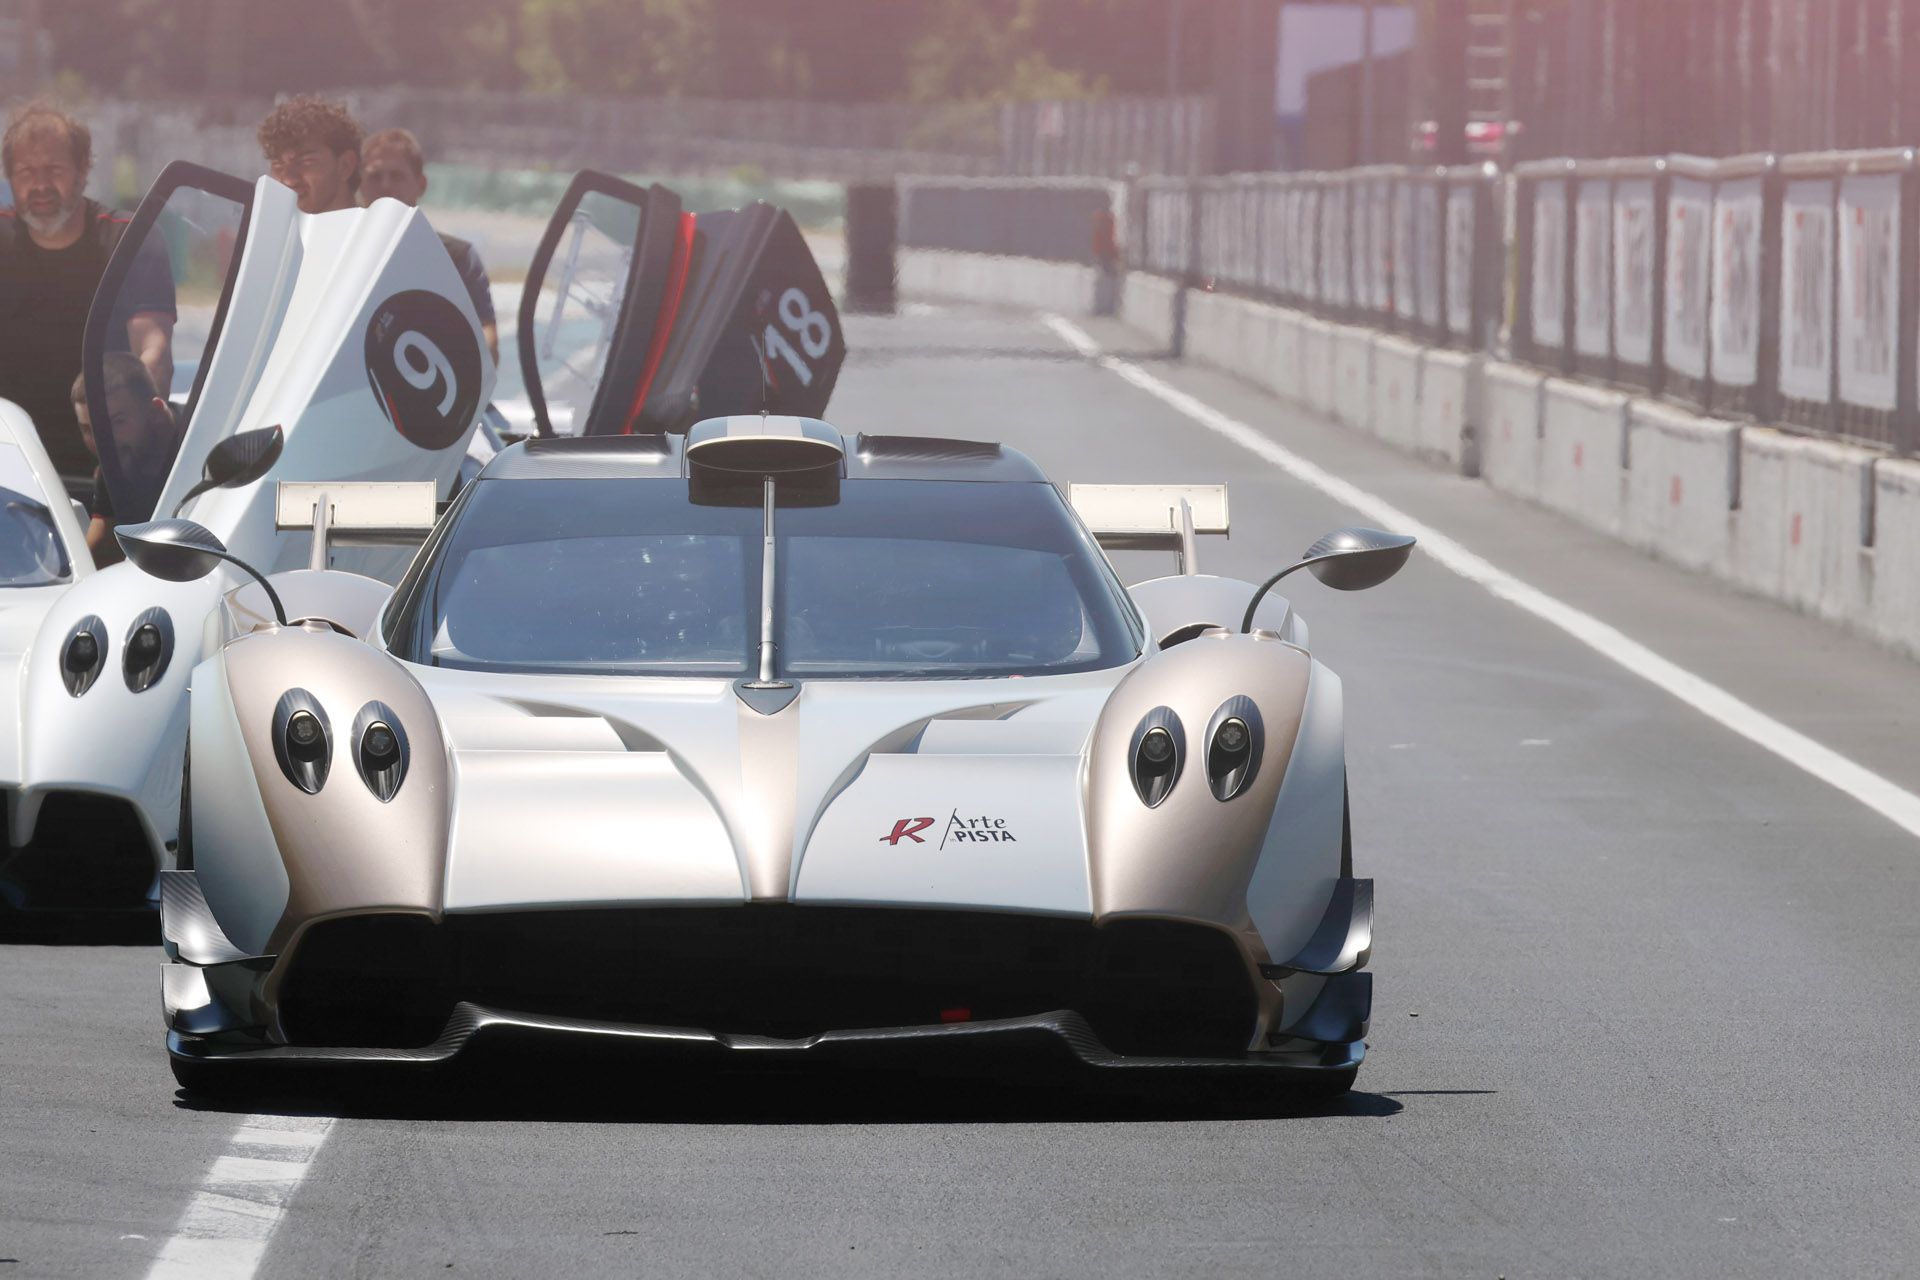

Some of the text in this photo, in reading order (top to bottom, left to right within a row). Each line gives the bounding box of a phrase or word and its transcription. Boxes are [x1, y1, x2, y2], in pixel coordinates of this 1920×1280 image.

[765, 287, 832, 387] 18
[393, 330, 457, 418] 9
[879, 817, 935, 846] R
[949, 813, 1006, 829] Arte
[954, 830, 1017, 842] PISTA
